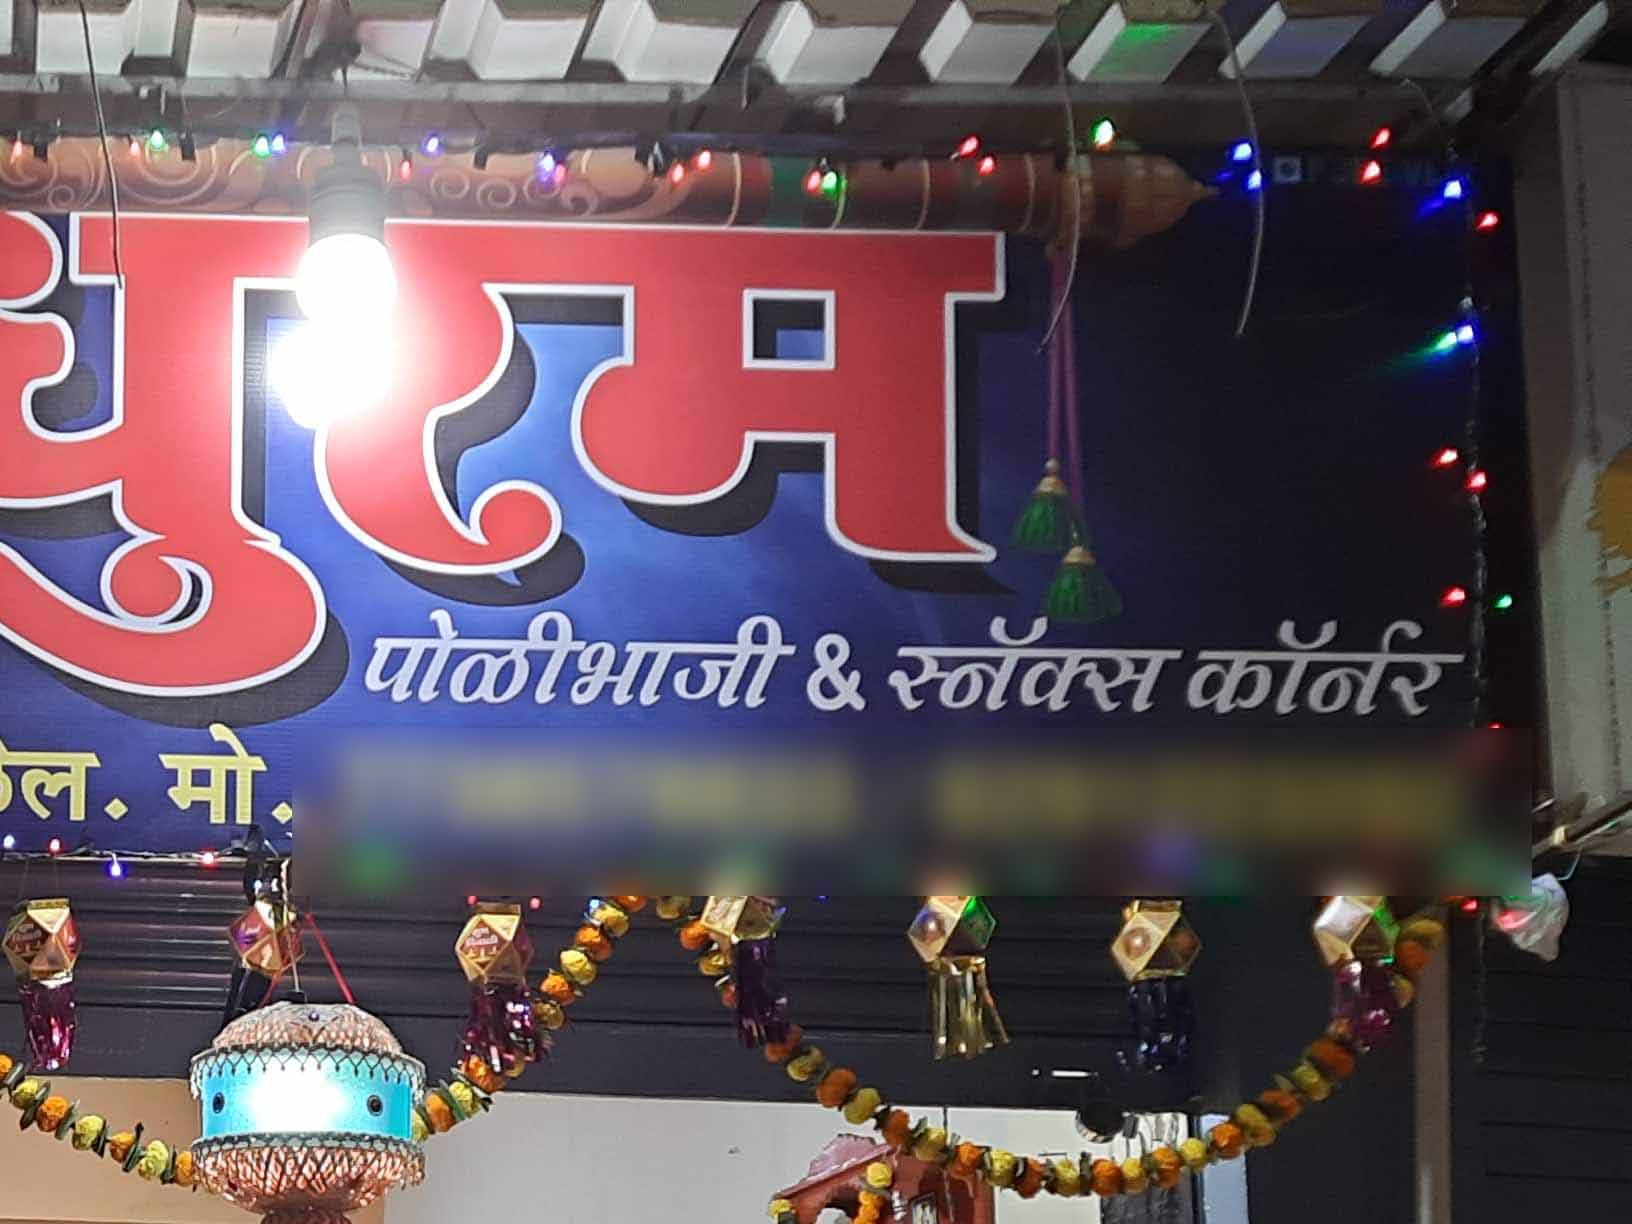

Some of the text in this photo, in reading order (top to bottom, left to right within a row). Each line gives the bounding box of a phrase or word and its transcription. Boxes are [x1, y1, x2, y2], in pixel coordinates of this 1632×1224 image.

[364, 608, 1465, 716] पोळीभाजी & स्नॅक्स कॉर्नर
